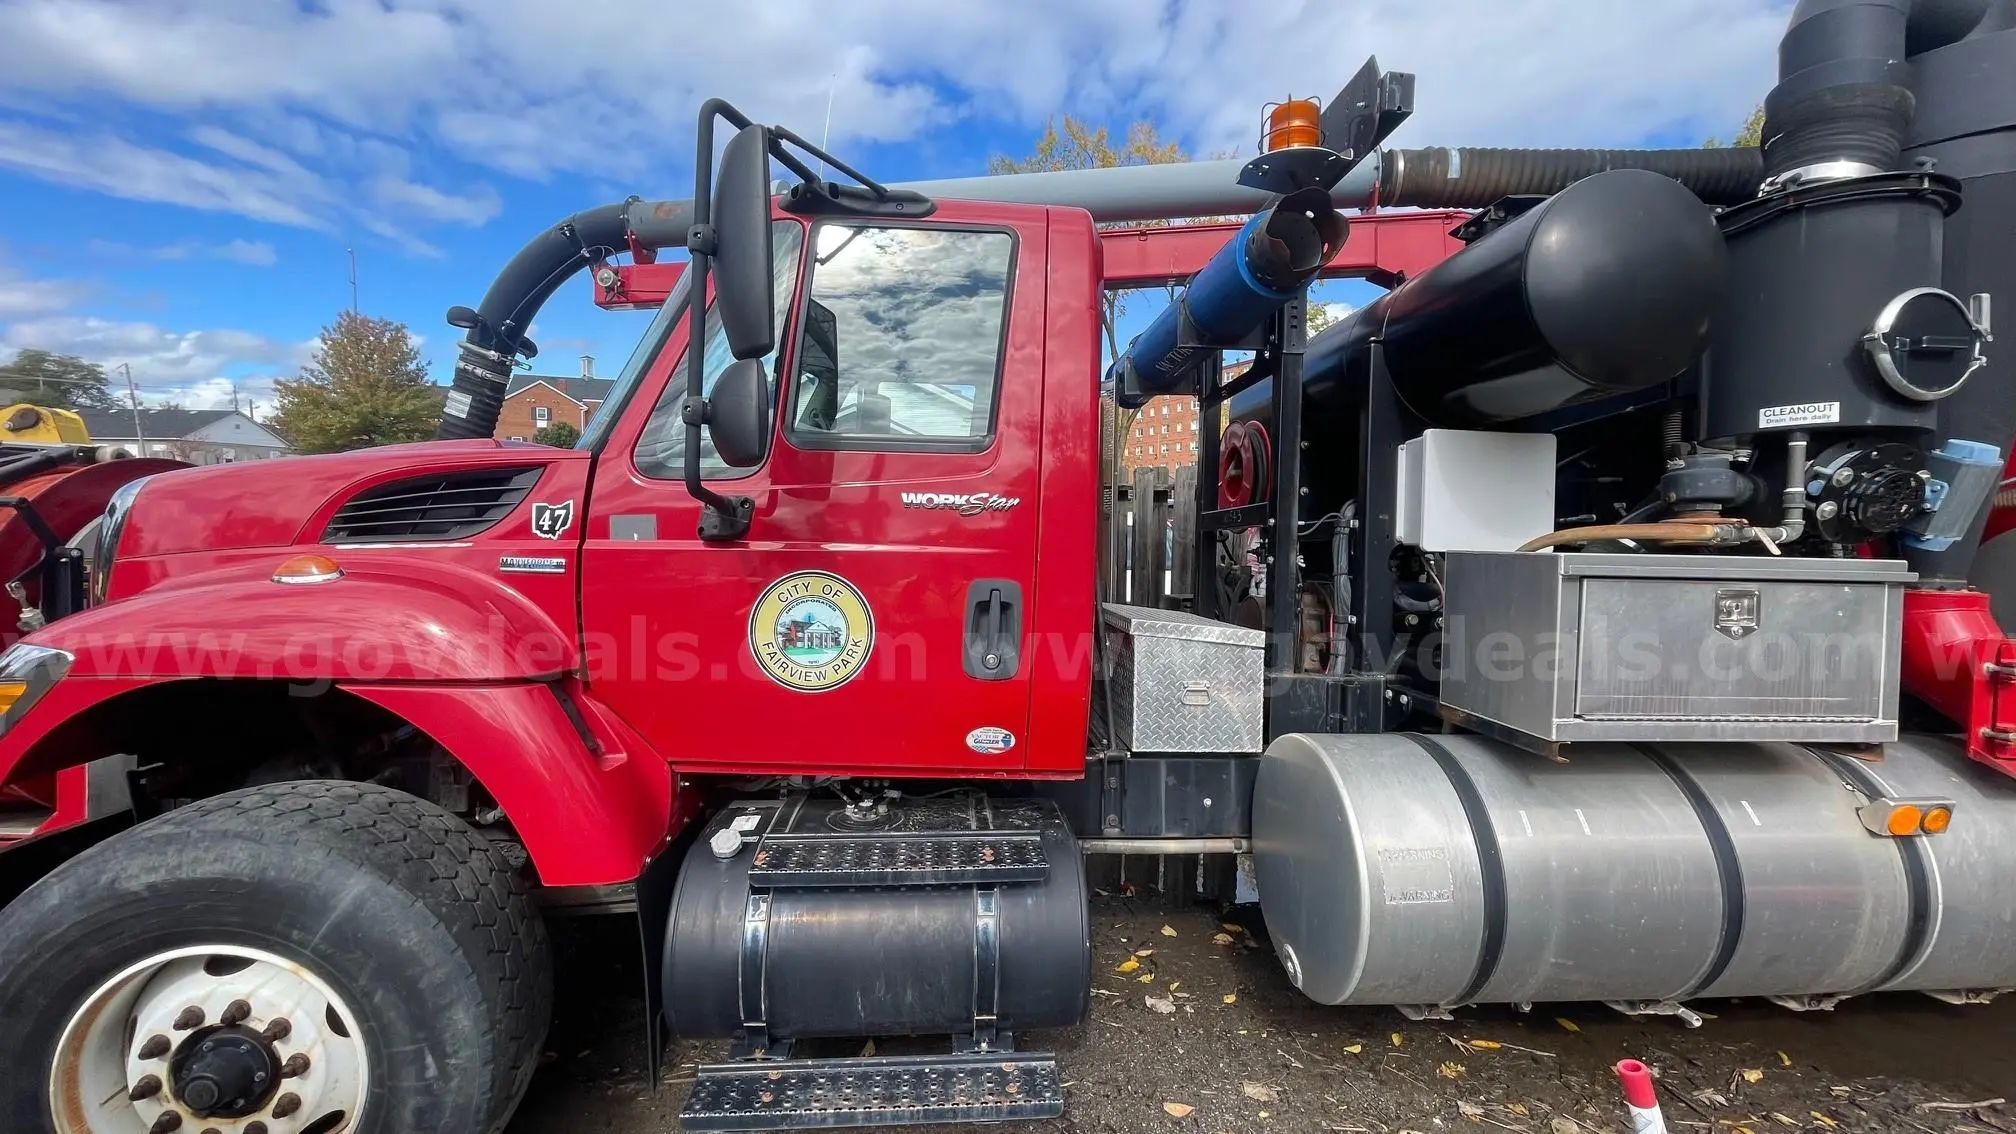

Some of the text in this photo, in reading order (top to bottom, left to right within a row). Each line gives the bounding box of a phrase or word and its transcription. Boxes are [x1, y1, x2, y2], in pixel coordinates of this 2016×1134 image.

[1763, 404, 1834, 417] CLEANOUT
[539, 509, 567, 531] 47
[777, 581, 844, 603] CITY OF
[785, 599, 837, 614] INCORPORATED
[762, 638, 863, 682] FAIRVIEW PARK
